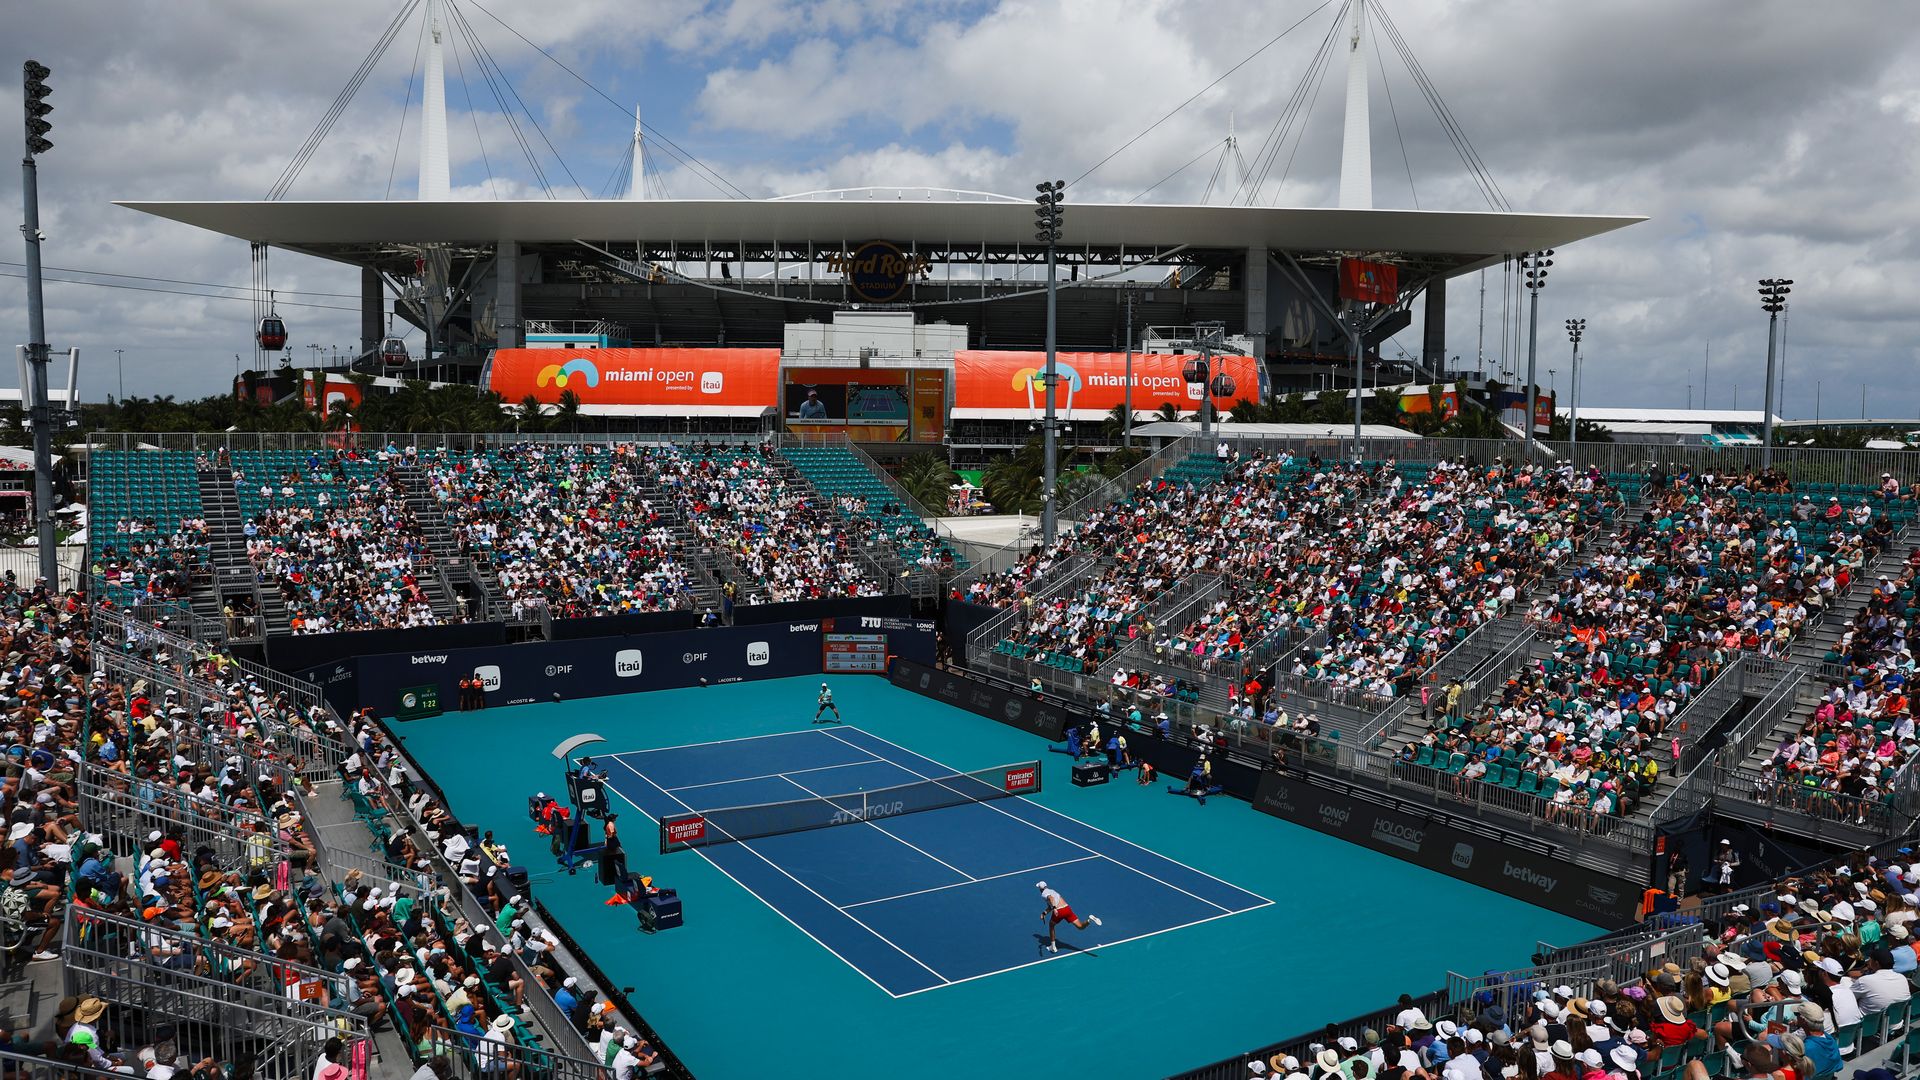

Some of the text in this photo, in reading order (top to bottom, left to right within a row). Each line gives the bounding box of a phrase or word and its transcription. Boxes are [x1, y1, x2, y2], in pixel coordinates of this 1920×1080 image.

[827, 254, 928, 279] Hard Rock
[859, 282, 897, 290] STADIUM
[605, 368, 694, 385] miami open
[1142, 375, 1180, 390] open
[702, 379, 720, 390] itaú
[790, 623, 819, 633] betway
[861, 616, 882, 629] FIU
[411, 654, 448, 665] betway
[693, 652, 708, 662] PIF
[749, 651, 767, 662] itaú
[557, 664, 573, 674] PIF
[618, 660, 639, 672] itaú
[328, 671, 353, 684] LACOSTE
[422, 699, 436, 708] 1:22
[1007, 771, 1034, 781] Emirates
[1017, 778, 1029, 786] BETTER
[1264, 795, 1295, 813] Protective
[830, 801, 904, 825] ATP TOUR
[670, 821, 704, 834] Emirates
[1322, 816, 1342, 828] SOLAR
[683, 829, 699, 838] BETTER
[1373, 817, 1424, 843] HOLOGIC
[1453, 851, 1471, 864] itaú
[1502, 860, 1558, 893] betway
[1575, 898, 1624, 920] CADILLAC
[660, 911, 680, 920] DUNLOP
